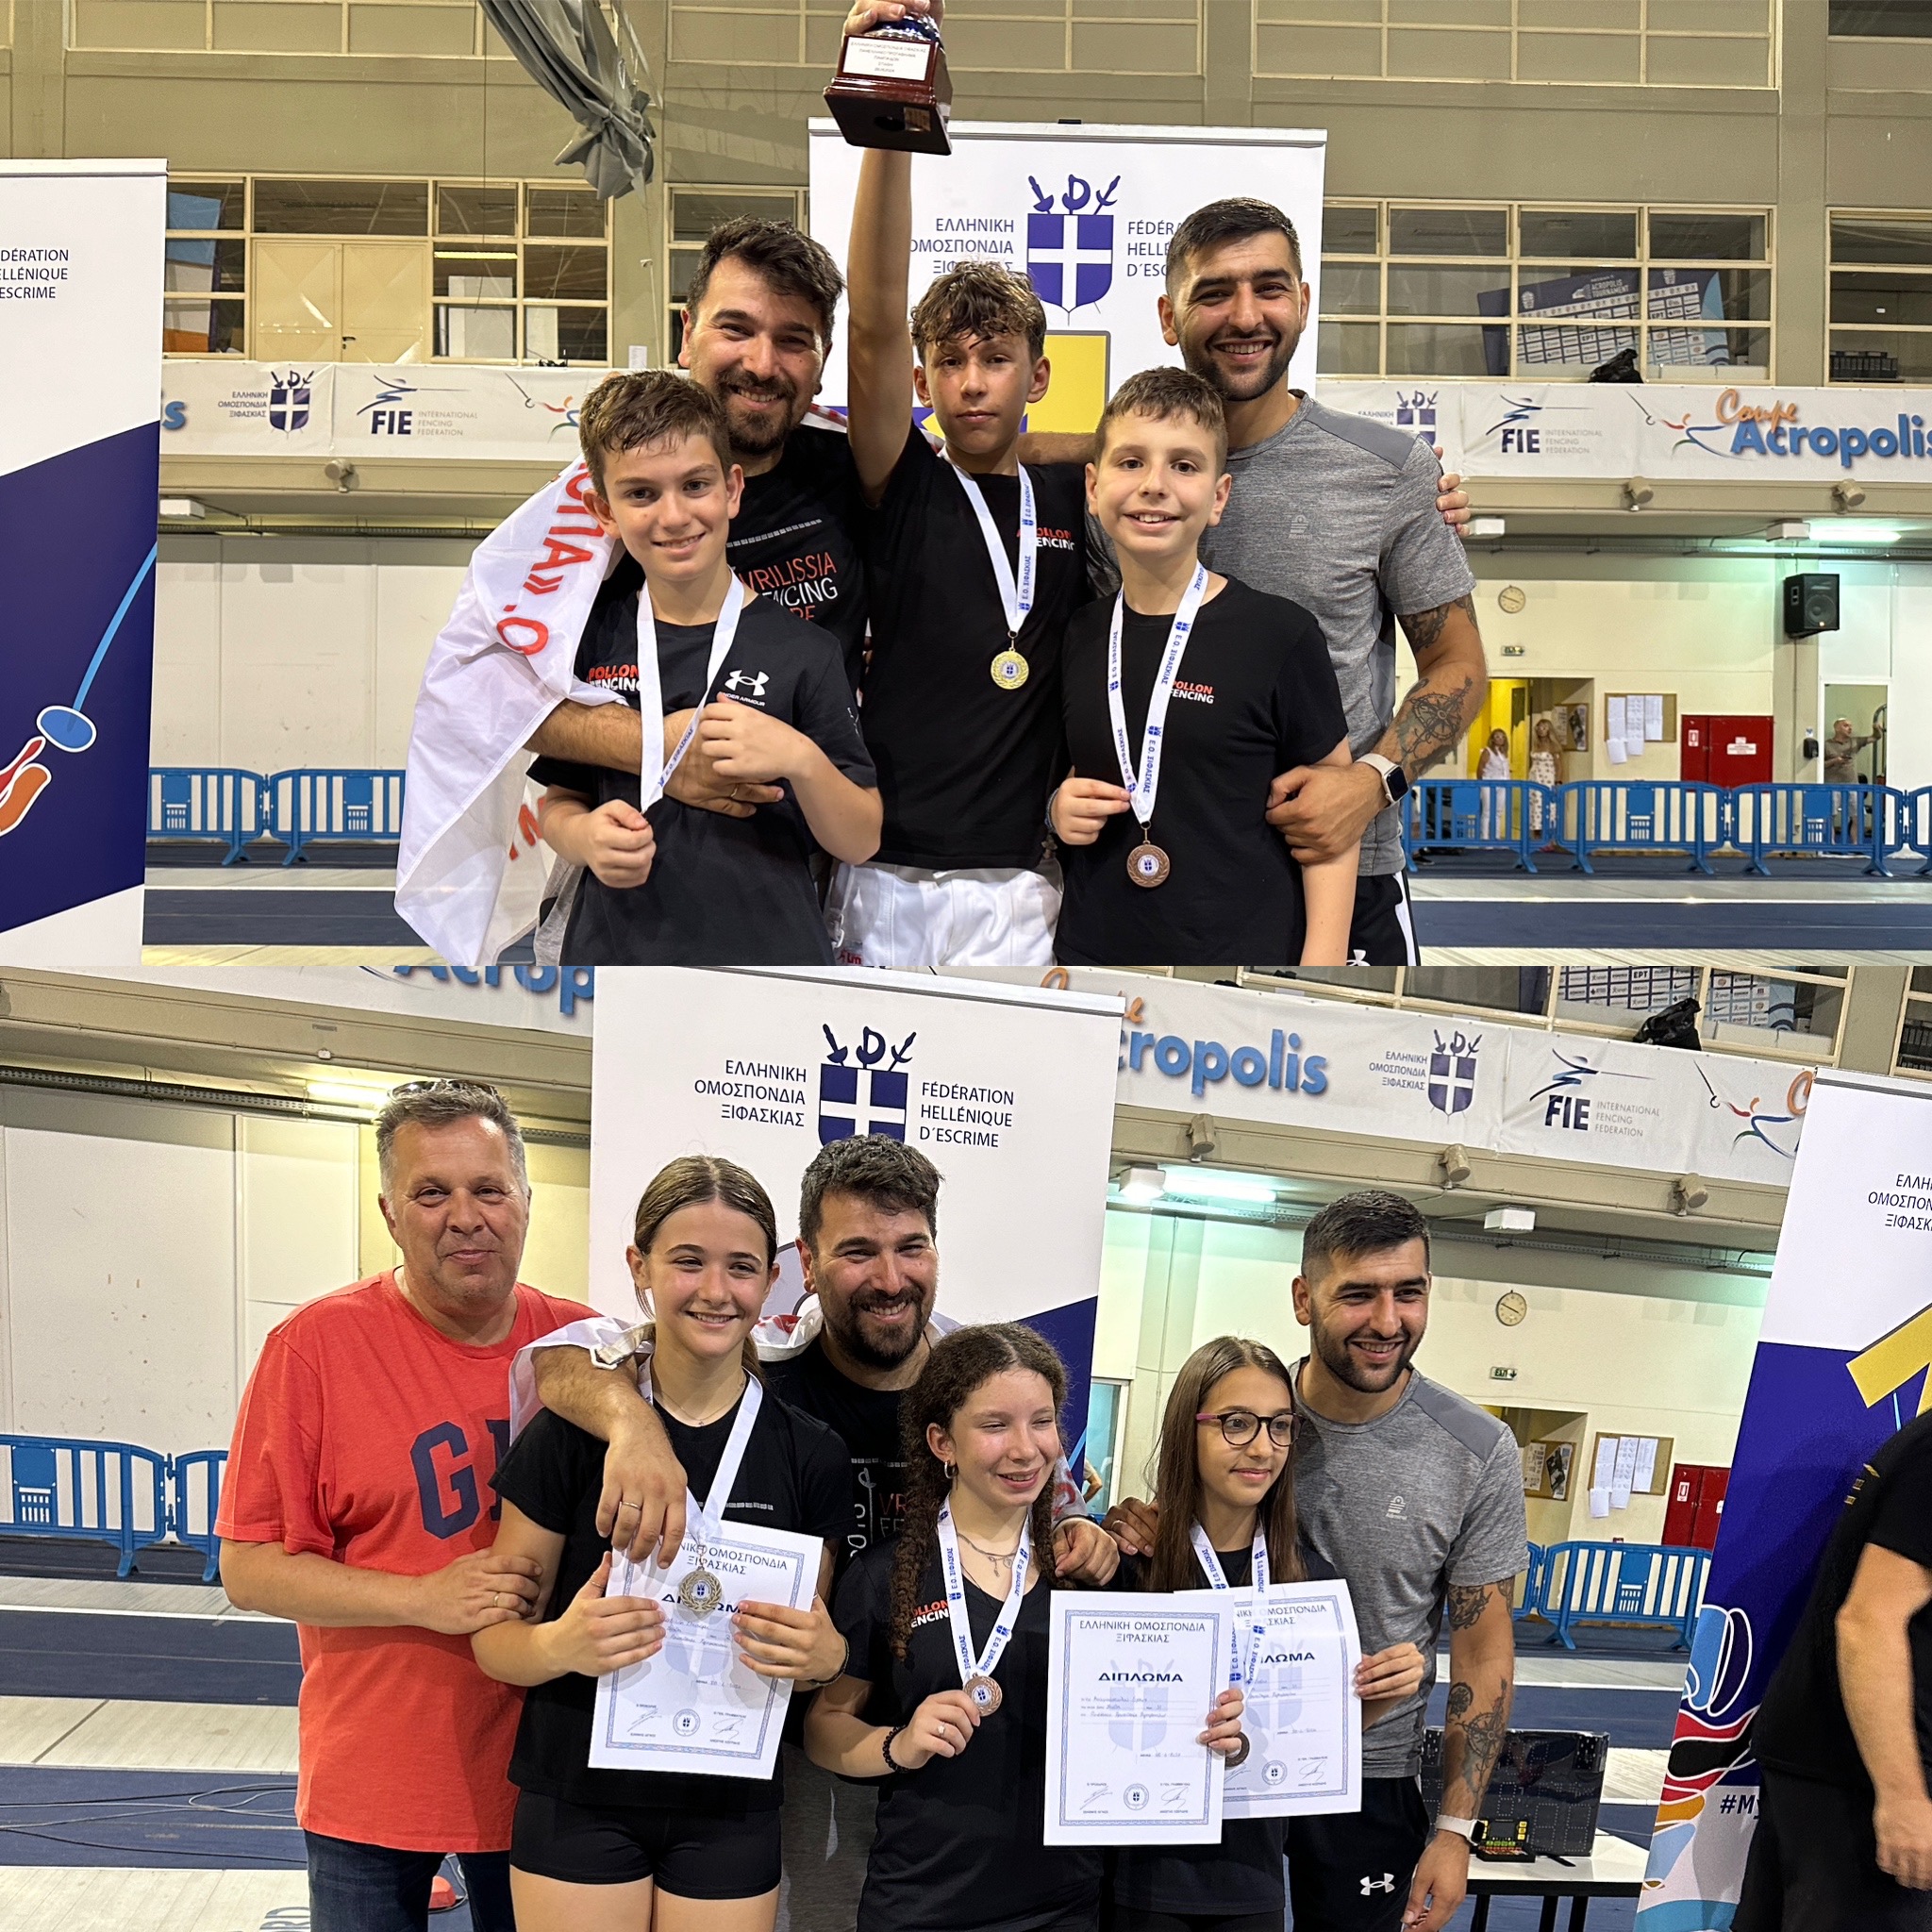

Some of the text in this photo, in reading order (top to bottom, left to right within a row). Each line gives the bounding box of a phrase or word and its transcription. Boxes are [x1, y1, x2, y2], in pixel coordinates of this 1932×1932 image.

[936, 218, 1014, 233] ΕΛΛΗΝΙΚΗ
[0, 267, 68, 281] LLÉNIQUE
[371, 410, 412, 435] FIE
[1502, 429, 1540, 453] FIE
[762, 577, 839, 606] NCING
[587, 664, 639, 682] POLLON
[740, 696, 765, 707] ARMOUR
[1118, 1028, 1328, 1095] ropolis
[1386, 1051, 1427, 1064] ΕΛΛΗΝΙΚΗ
[725, 1059, 807, 1082] ΕΛΛΗΝΙΚΗ
[1369, 1062, 1426, 1077] ΟΜΟΣΠΟΝΔΙΑ
[694, 1079, 805, 1105] ΟΜΟΣΠΟΝΔΙΑ
[1382, 1077, 1424, 1091] ΞΙΦΑΣΚΙΑΣ
[922, 1081, 1014, 1106] FÉDÉRATION
[722, 1104, 804, 1127] ΞΙΦΑΣΚΙΑΣ
[921, 1104, 1012, 1127] HELLÉNIQUE
[1545, 1094, 1591, 1130] FIE
[1597, 1101, 1659, 1116] INTERNATIONAL
[1596, 1113, 1633, 1124] FENCING
[1595, 1124, 1643, 1137] FEDERATION
[1896, 1174, 1932, 1191] ΕΛΛΗ
[708, 1547, 788, 1571] ΟΜΟΣΠΟΝΔΙΑ
[1079, 1620, 1206, 1632] ΕΛΛΗΝΙΚΗ ΟΜΟΣΠΟΝΔΙΑ
[1116, 1633, 1170, 1643] ΞΙΦΑΣΚΙΑΣ
[1098, 1672, 1183, 1682] ΔΙΠΛΩΜΑ
